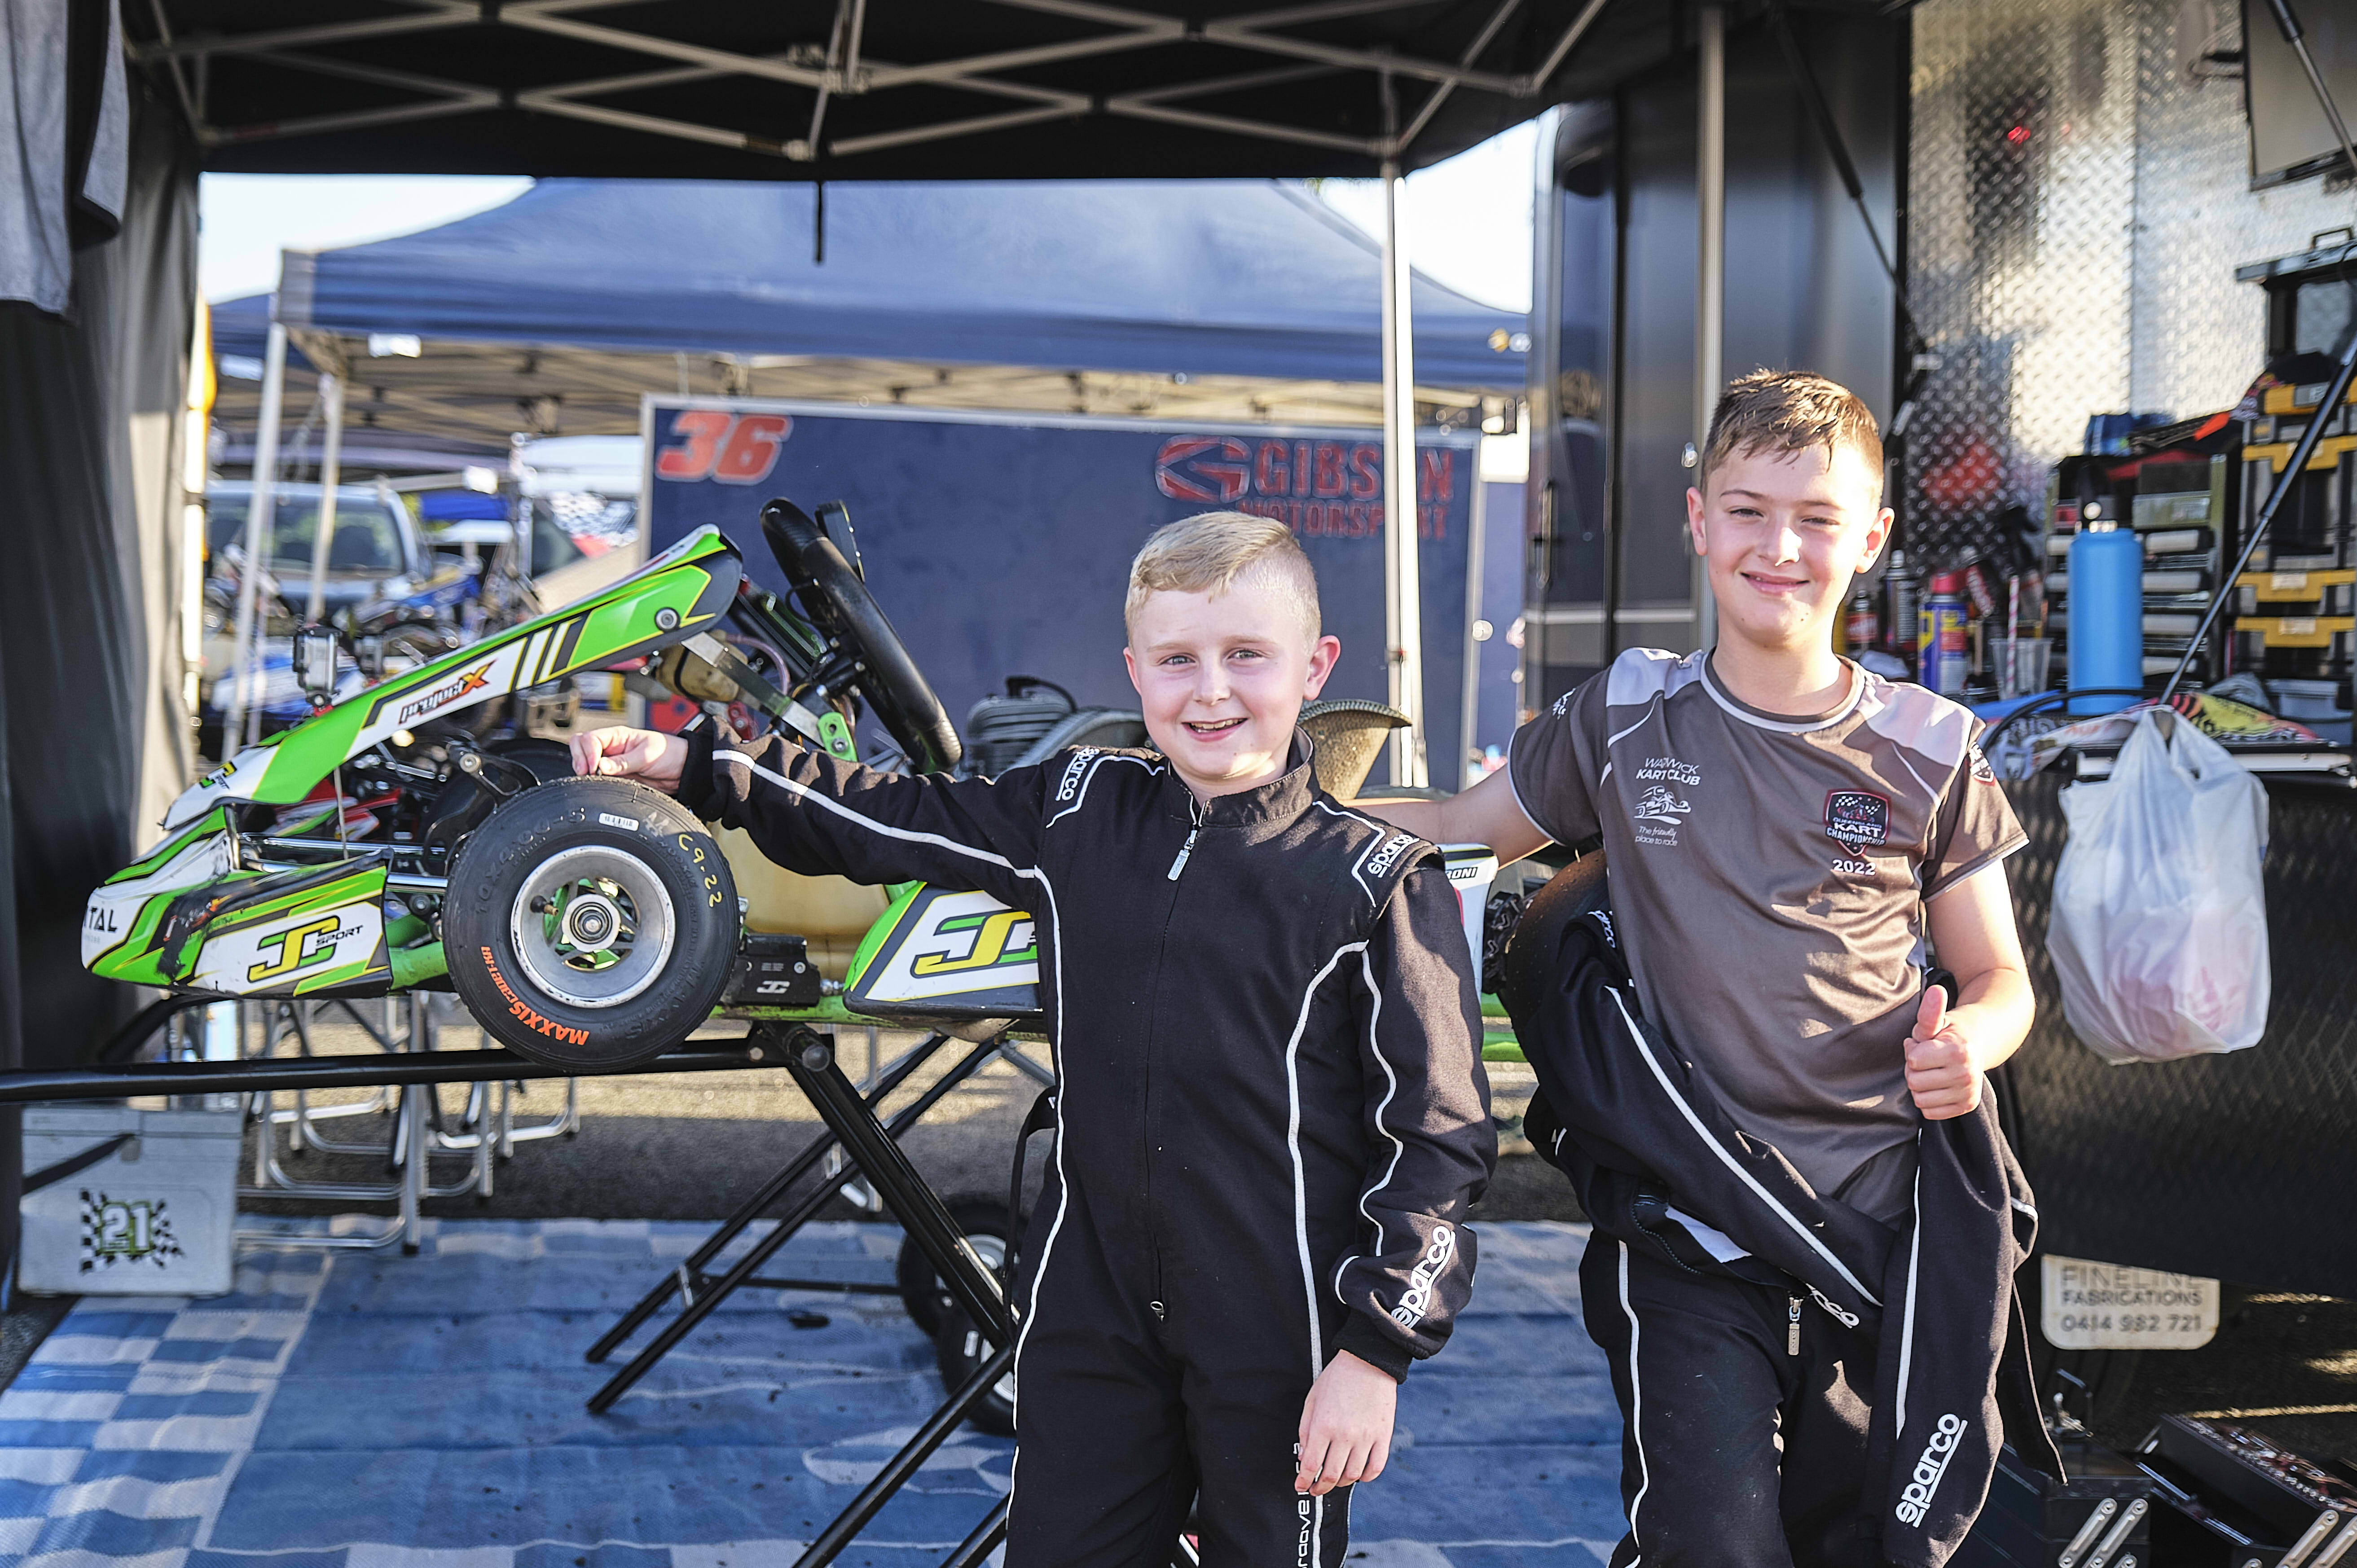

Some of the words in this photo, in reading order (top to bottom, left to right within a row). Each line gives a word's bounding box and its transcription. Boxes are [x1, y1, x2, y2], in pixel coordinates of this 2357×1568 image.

[655, 409, 794, 486] 36
[1254, 438, 1454, 504] GIBSN
[1826, 827, 1886, 846] CHAMPIONSHIP
[1834, 822, 1882, 838] KART
[1832, 859, 1876, 876] 2022
[316, 925, 364, 946] SPORT
[509, 1001, 589, 1045] MAXXIS
[100, 1201, 152, 1255] 21
[1391, 1225, 1456, 1329] sparco
[2061, 1289, 2202, 1308] FABRICATIONS
[2061, 1314, 2111, 1333] 0414
[2168, 1314, 2201, 1333] 721
[1895, 1413, 1968, 1528] sparco
[1297, 1499, 1311, 1568] roove
